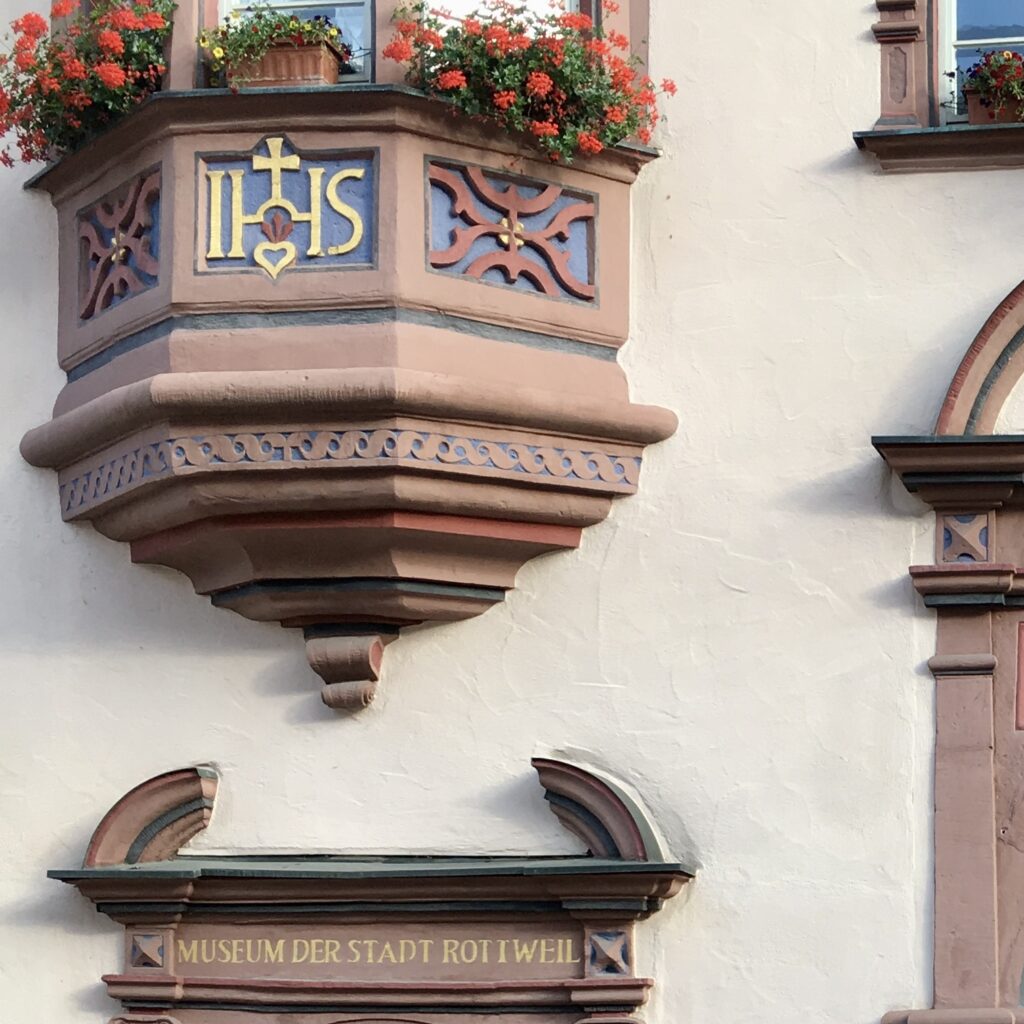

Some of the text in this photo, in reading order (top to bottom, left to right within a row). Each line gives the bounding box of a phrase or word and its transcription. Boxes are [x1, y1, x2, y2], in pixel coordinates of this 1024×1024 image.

[178, 938, 581, 964] MUSEUM DER STADT ROTTWEIL
